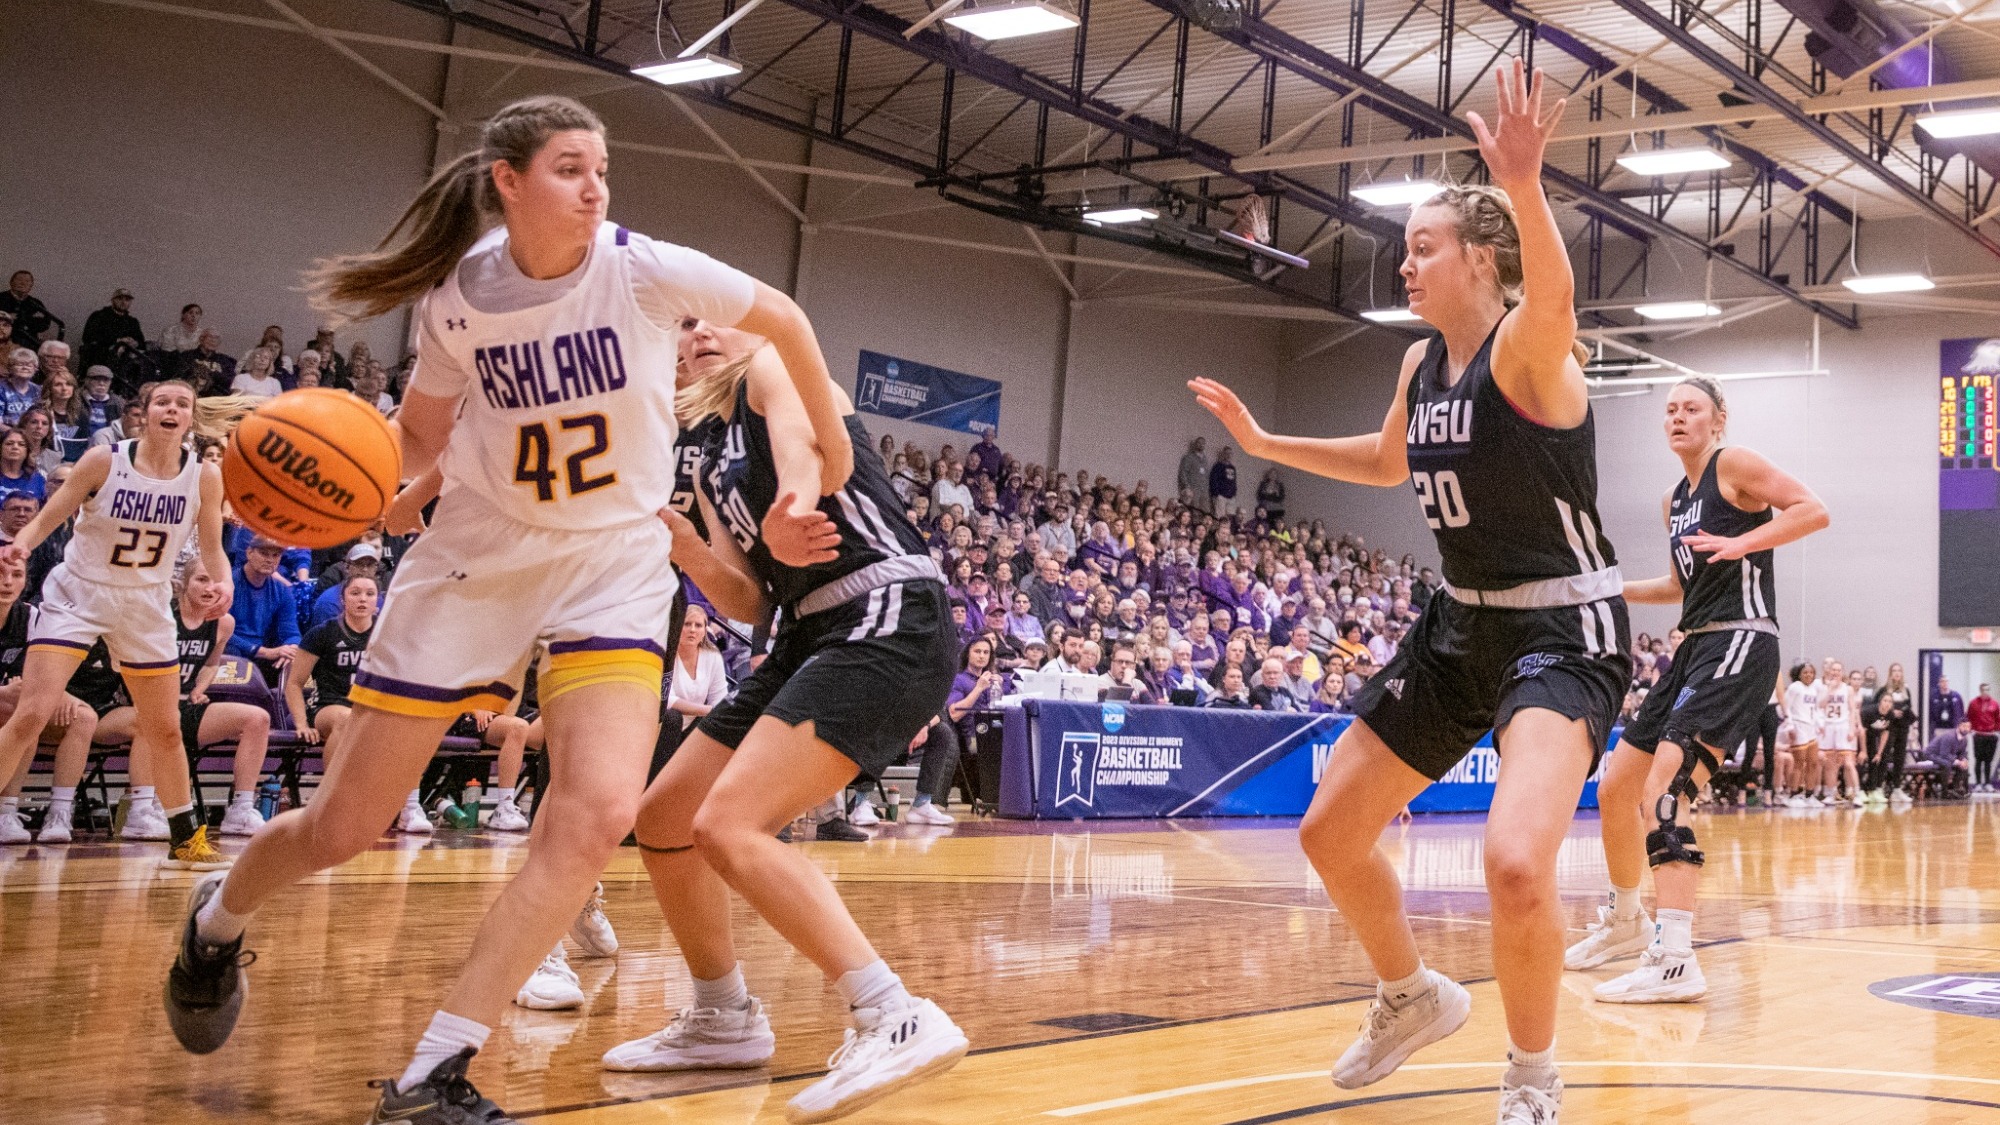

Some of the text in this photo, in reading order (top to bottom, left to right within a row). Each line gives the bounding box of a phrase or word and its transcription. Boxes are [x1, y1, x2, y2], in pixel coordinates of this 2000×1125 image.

[475, 326, 627, 409] ASHLAND
[1985, 386, 1993, 399] 2
[1985, 400, 1993, 413] 3
[257, 429, 355, 510] Wilson
[512, 411, 619, 503] 42
[110, 488, 187, 524] ASHLAND
[1412, 470, 1471, 530] 20
[1670, 499, 1703, 538] GVSU
[109, 526, 168, 569] 23
[1674, 544, 1694, 581] 14
[1104, 713, 1125, 724] NCAA
[1827, 705, 1841, 718] 24
[1099, 746, 1183, 769] BASKETBALL
[1102, 735, 1118, 745] 2023
[1119, 736, 1148, 746] DIVISION
[1156, 737, 1183, 747] WOMEN'S
[1096, 770, 1170, 786] CHAMPIONSHIP
